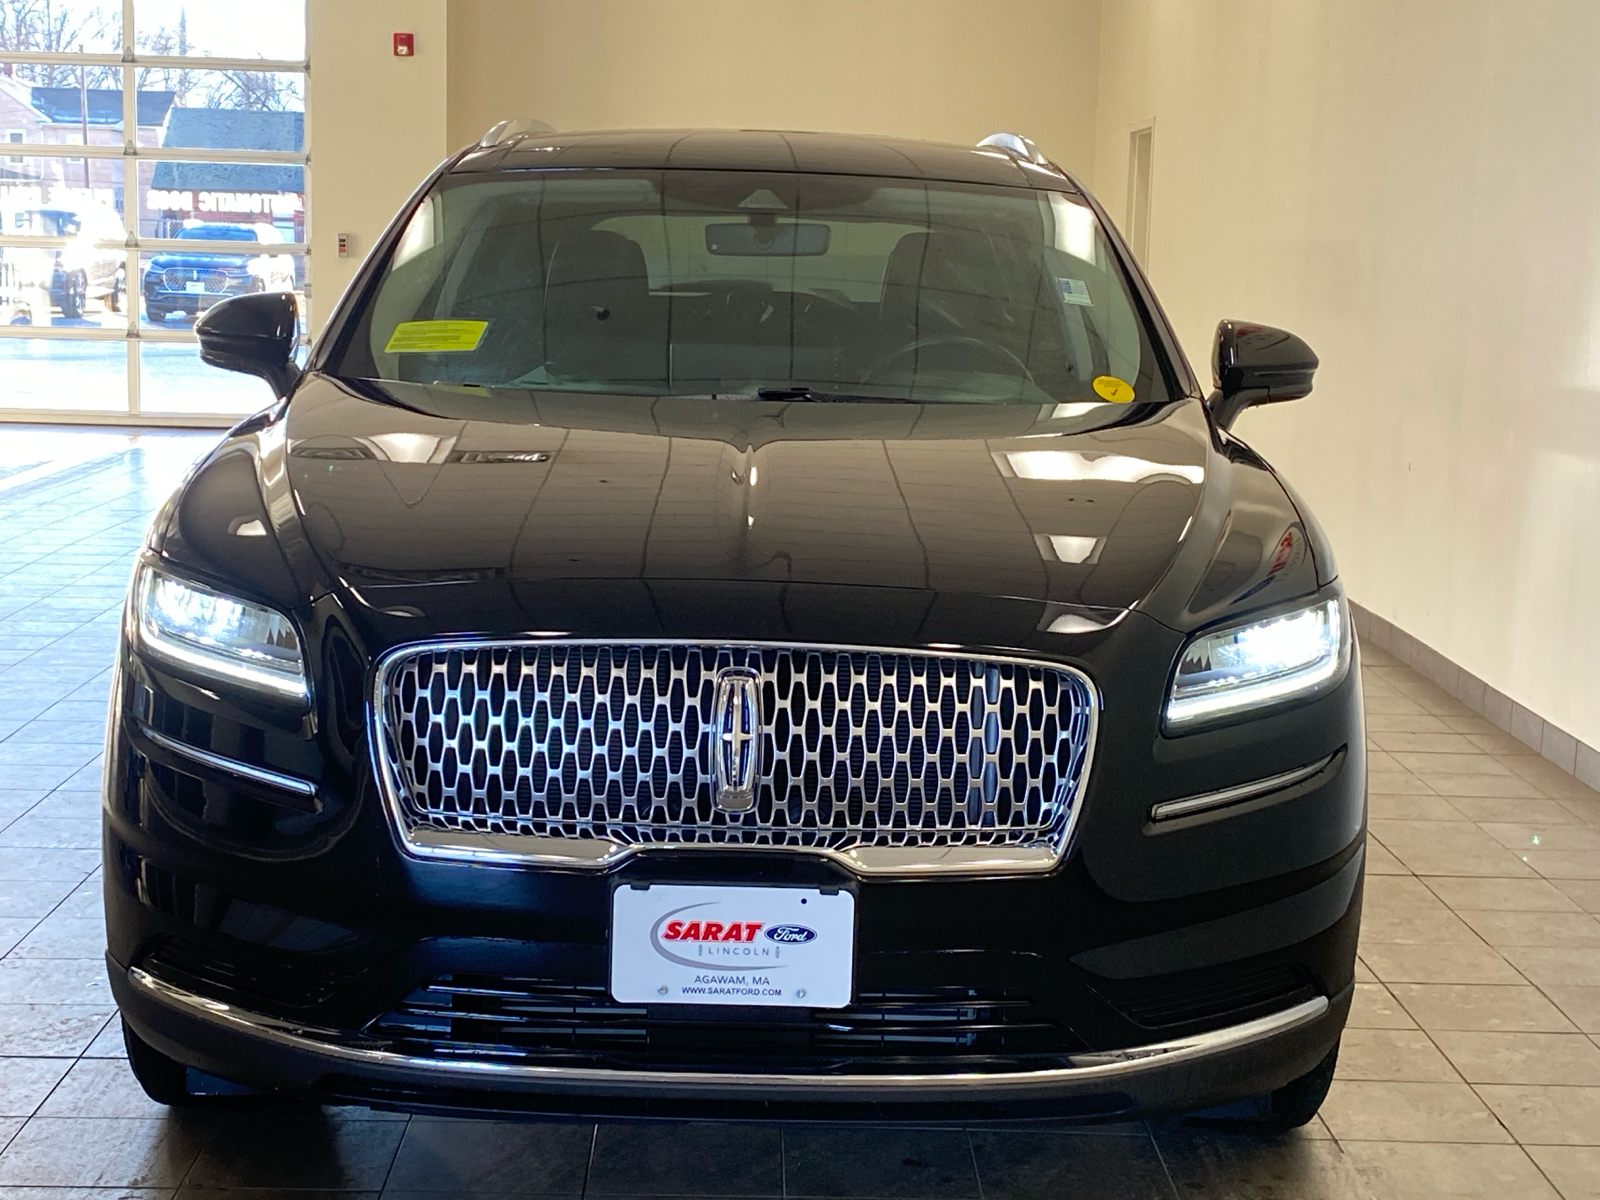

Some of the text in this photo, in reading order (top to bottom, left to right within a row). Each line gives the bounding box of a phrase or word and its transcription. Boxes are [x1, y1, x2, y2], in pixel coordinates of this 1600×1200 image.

[661, 920, 808, 943] SARAT Ford
[708, 946, 770, 956] LINCOLN
[694, 974, 771, 986] AGAWAM, MA
[681, 986, 782, 996] WWW.SARATFORD.COM
